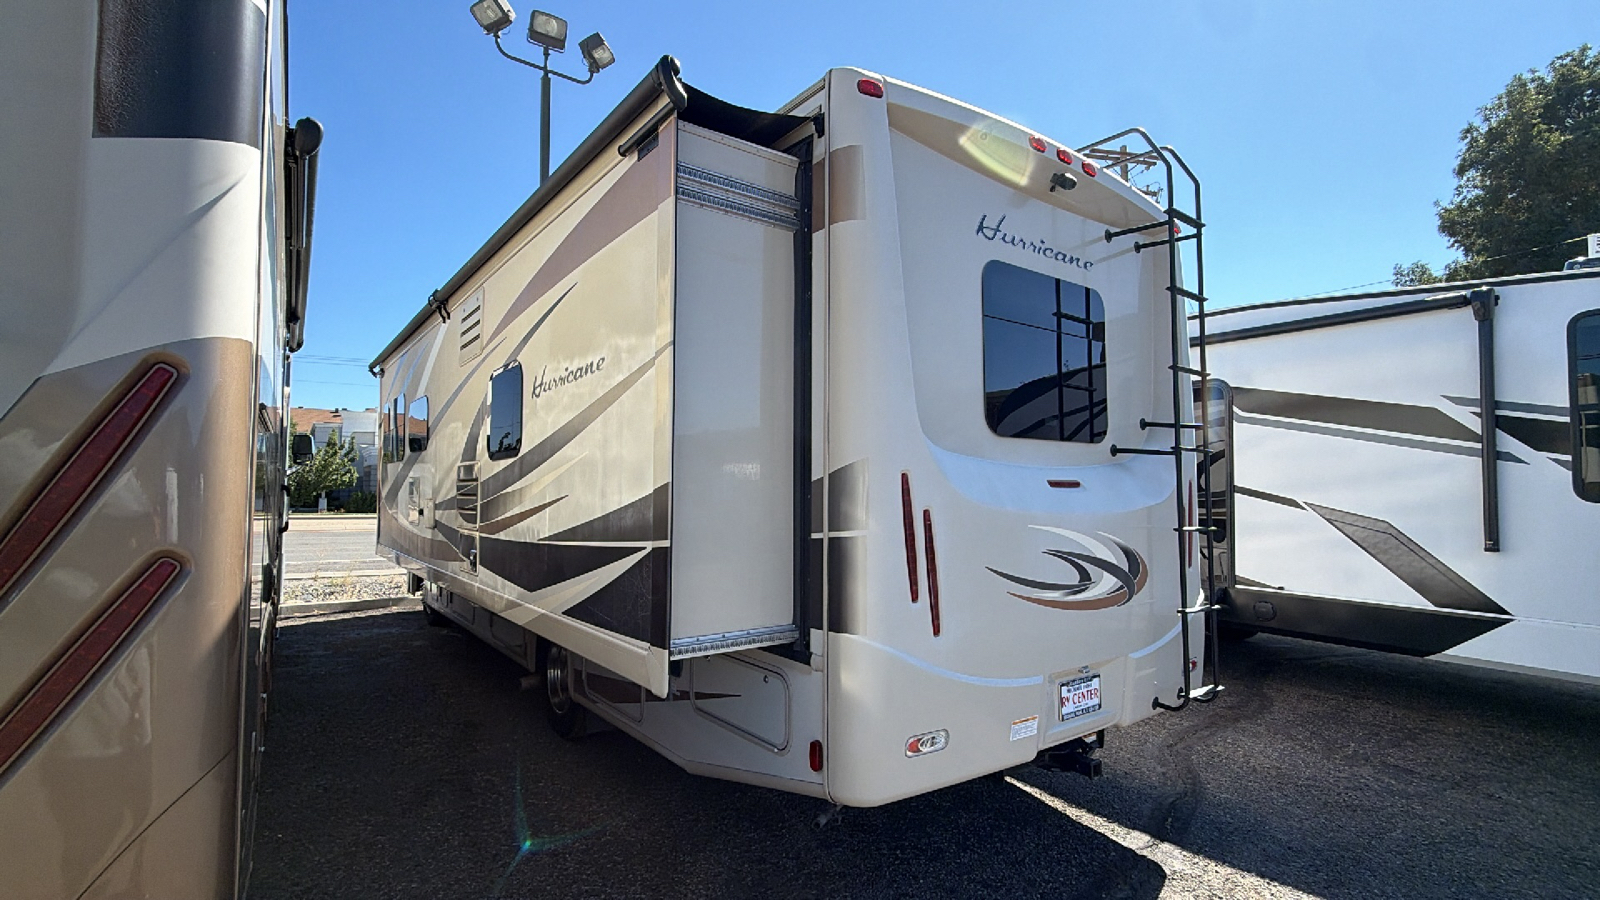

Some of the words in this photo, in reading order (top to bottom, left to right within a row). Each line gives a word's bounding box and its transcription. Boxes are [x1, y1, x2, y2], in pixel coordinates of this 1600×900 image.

[976, 213, 1094, 272] Hurricane
[531, 356, 606, 400] Hurricane
[1061, 694, 1070, 708] RV
[1072, 687, 1099, 705] CENTER
